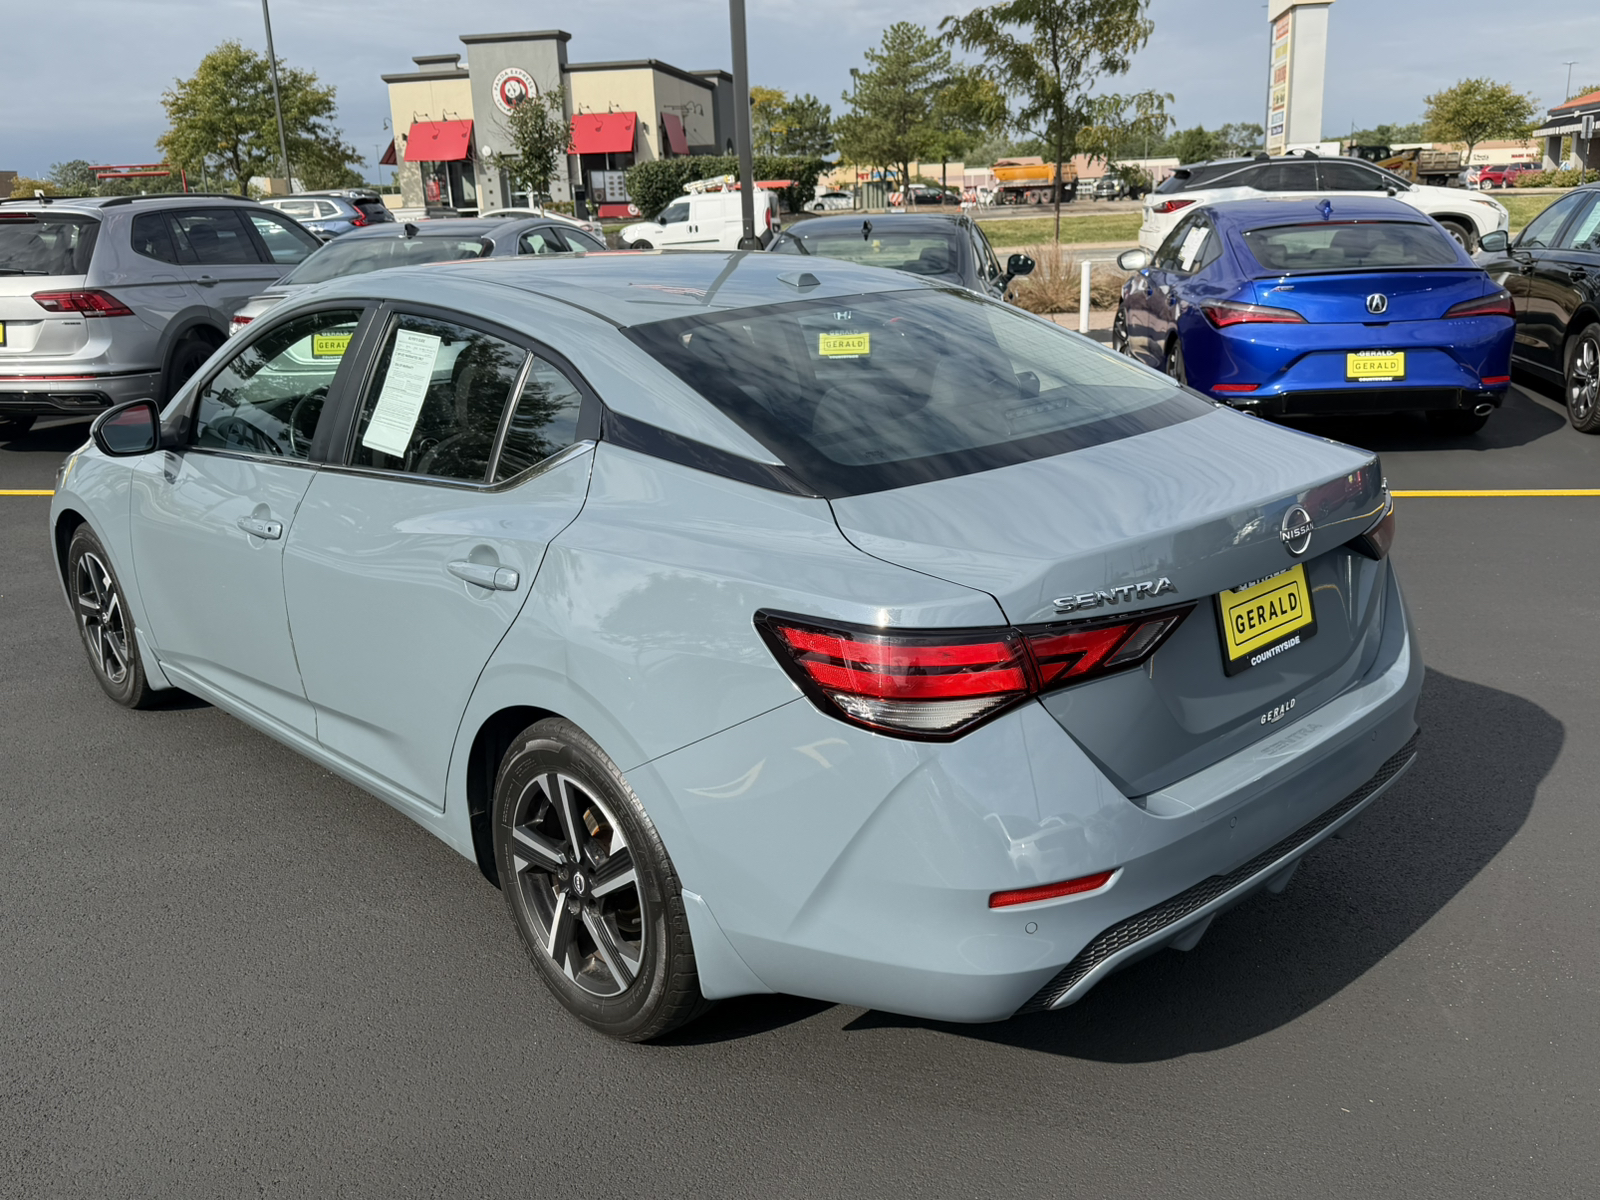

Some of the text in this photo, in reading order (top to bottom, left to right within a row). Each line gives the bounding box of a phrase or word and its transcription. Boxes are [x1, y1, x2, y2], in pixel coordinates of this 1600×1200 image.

[494, 69, 534, 91] PANDA EXPRESS
[318, 341, 347, 349] GERAL
[1355, 362, 1396, 370] GERALD
[1282, 523, 1314, 541] NISSAN
[1053, 577, 1176, 613] SENTRA
[1235, 592, 1298, 634] GERALD
[1250, 635, 1301, 666] COUNTRYSIDE
[1261, 698, 1296, 725] GERALD
